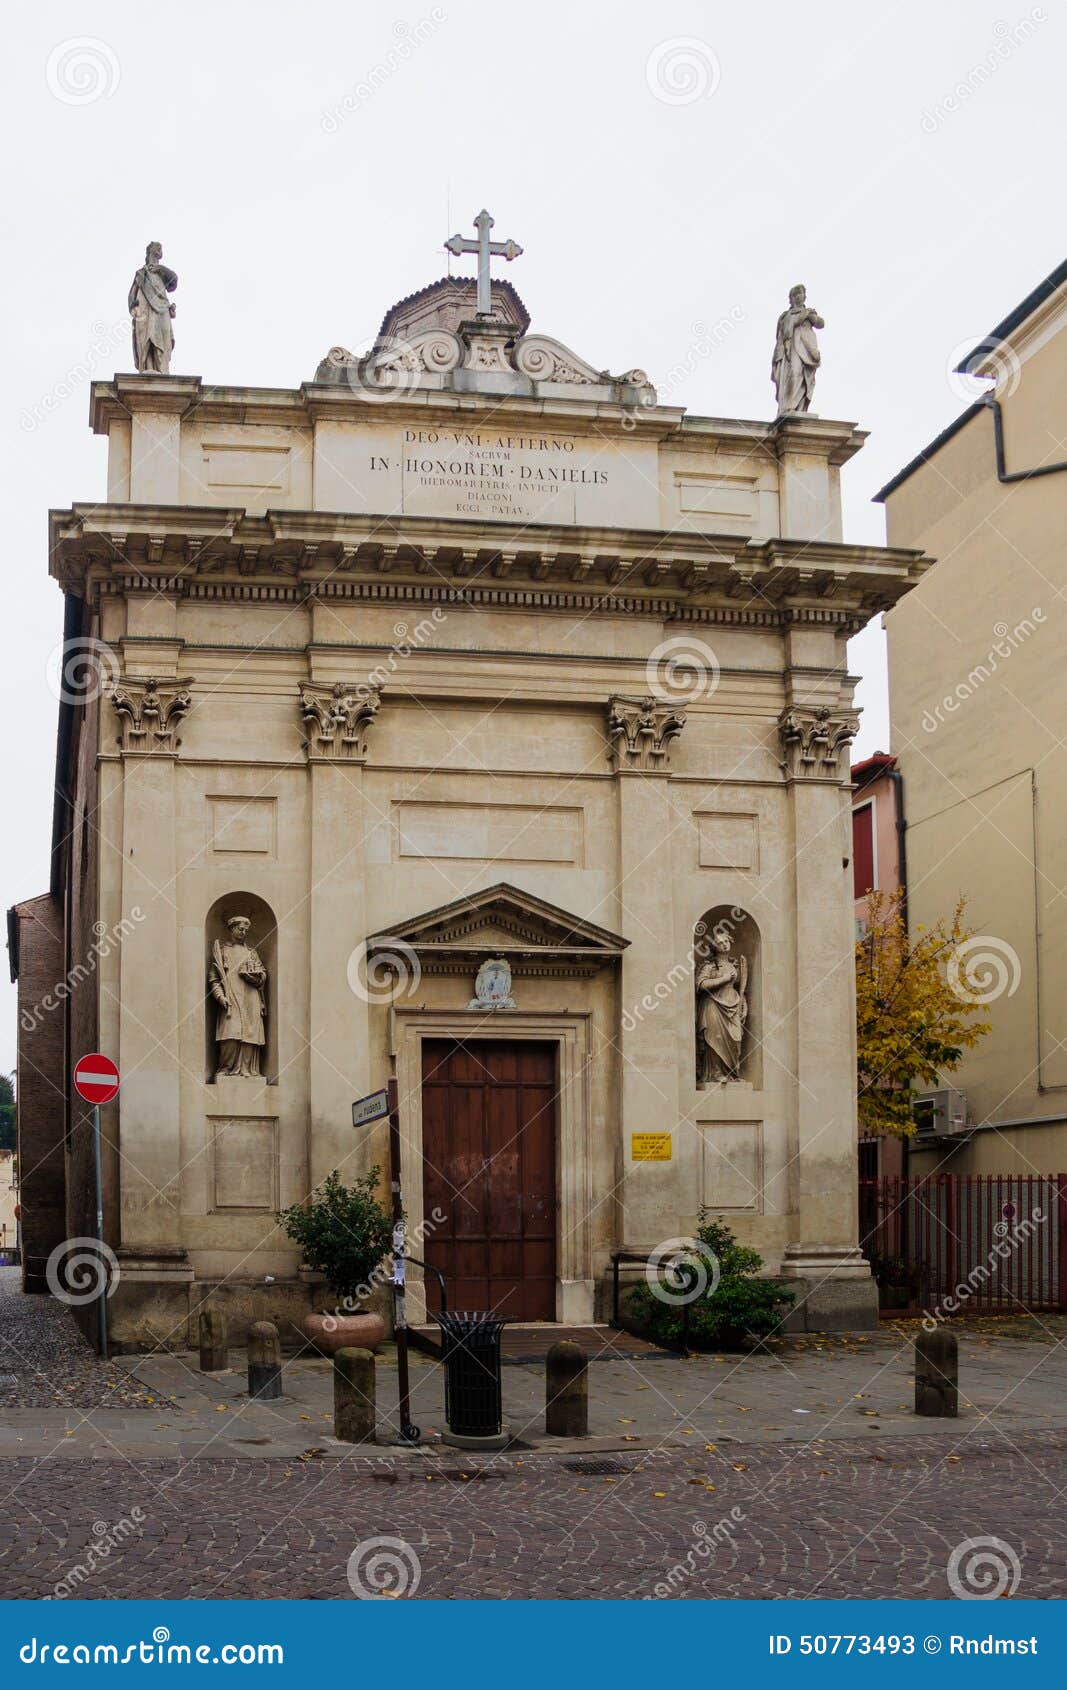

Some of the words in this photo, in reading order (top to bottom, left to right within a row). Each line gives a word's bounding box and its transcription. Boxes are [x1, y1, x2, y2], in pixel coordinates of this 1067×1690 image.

[405, 431, 440, 444] DEO
[495, 436, 575, 453] AETERNO
[370, 456, 390, 471] IN
[406, 458, 504, 477] HONOREM
[519, 465, 609, 484] DANIELIS
[468, 491, 513, 502] DIACONI
[519, 482, 560, 494] INVICTI
